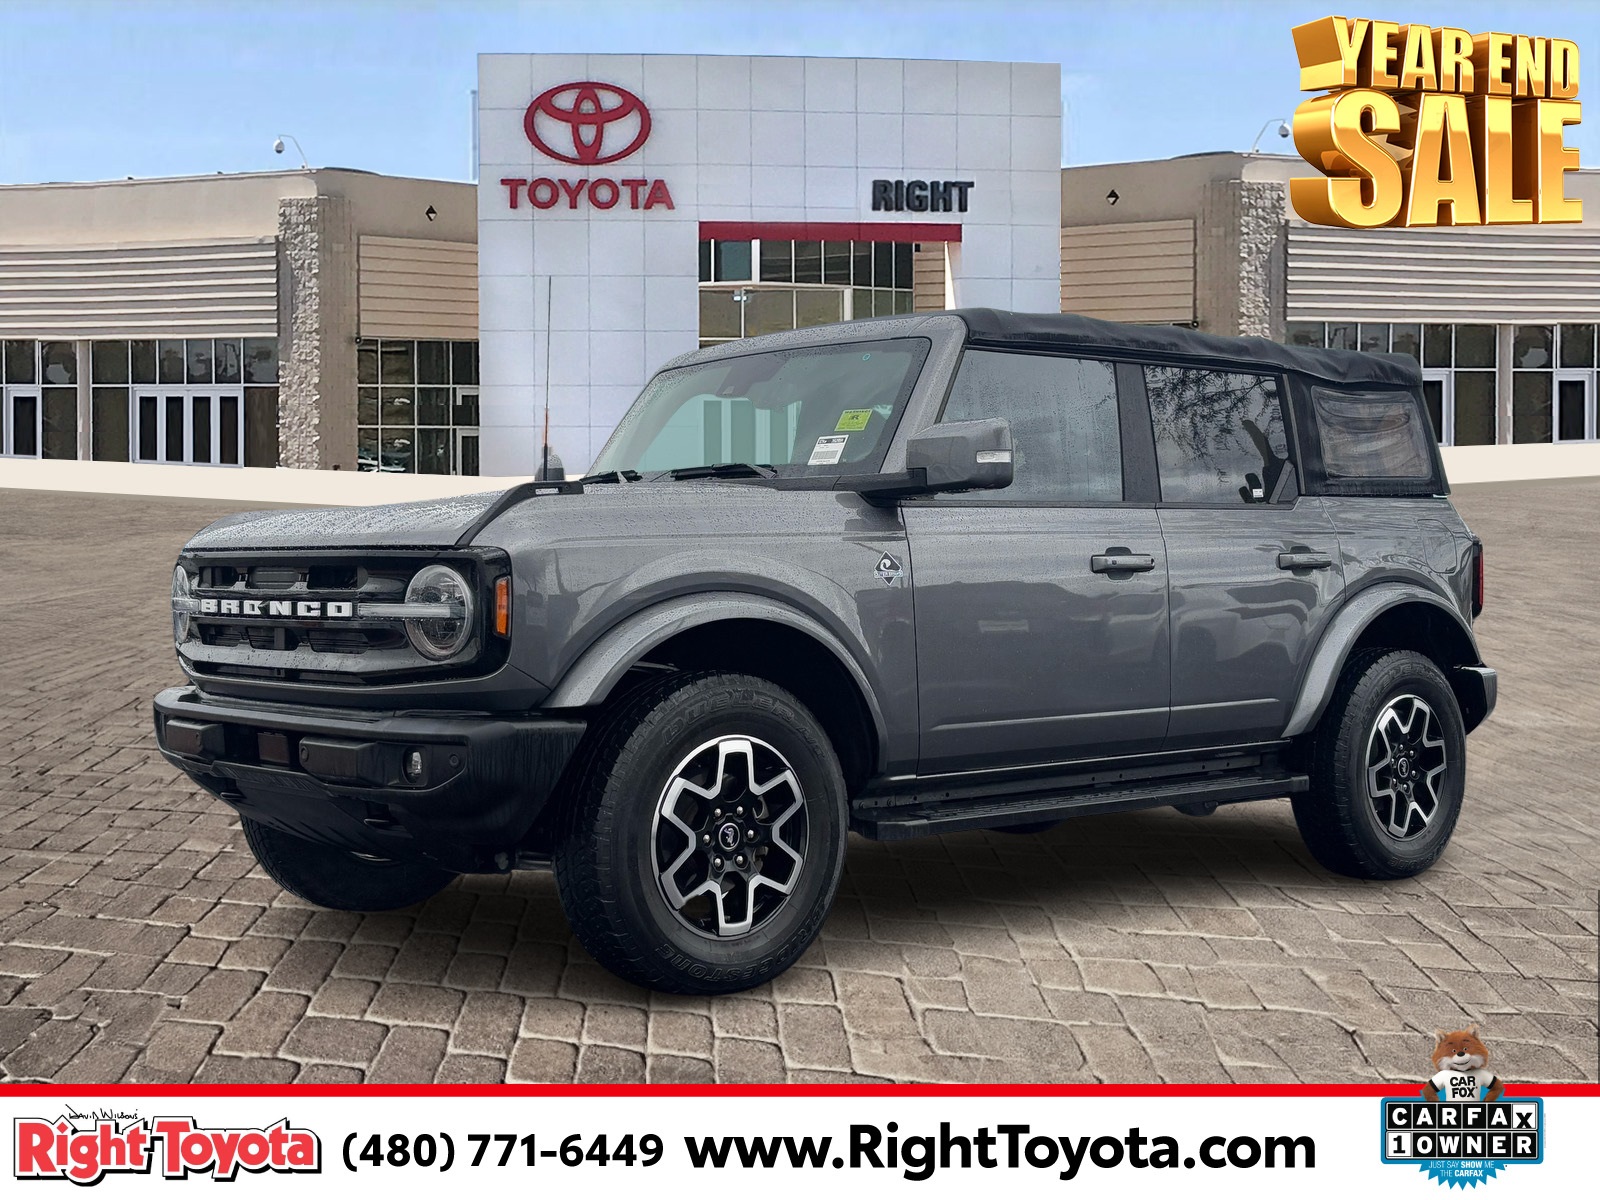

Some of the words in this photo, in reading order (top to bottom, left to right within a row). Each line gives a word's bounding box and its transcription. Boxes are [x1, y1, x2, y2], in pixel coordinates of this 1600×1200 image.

[501, 179, 675, 209] TOYOTA
[872, 180, 975, 212] RIGHT
[200, 598, 353, 618] BRONCO
